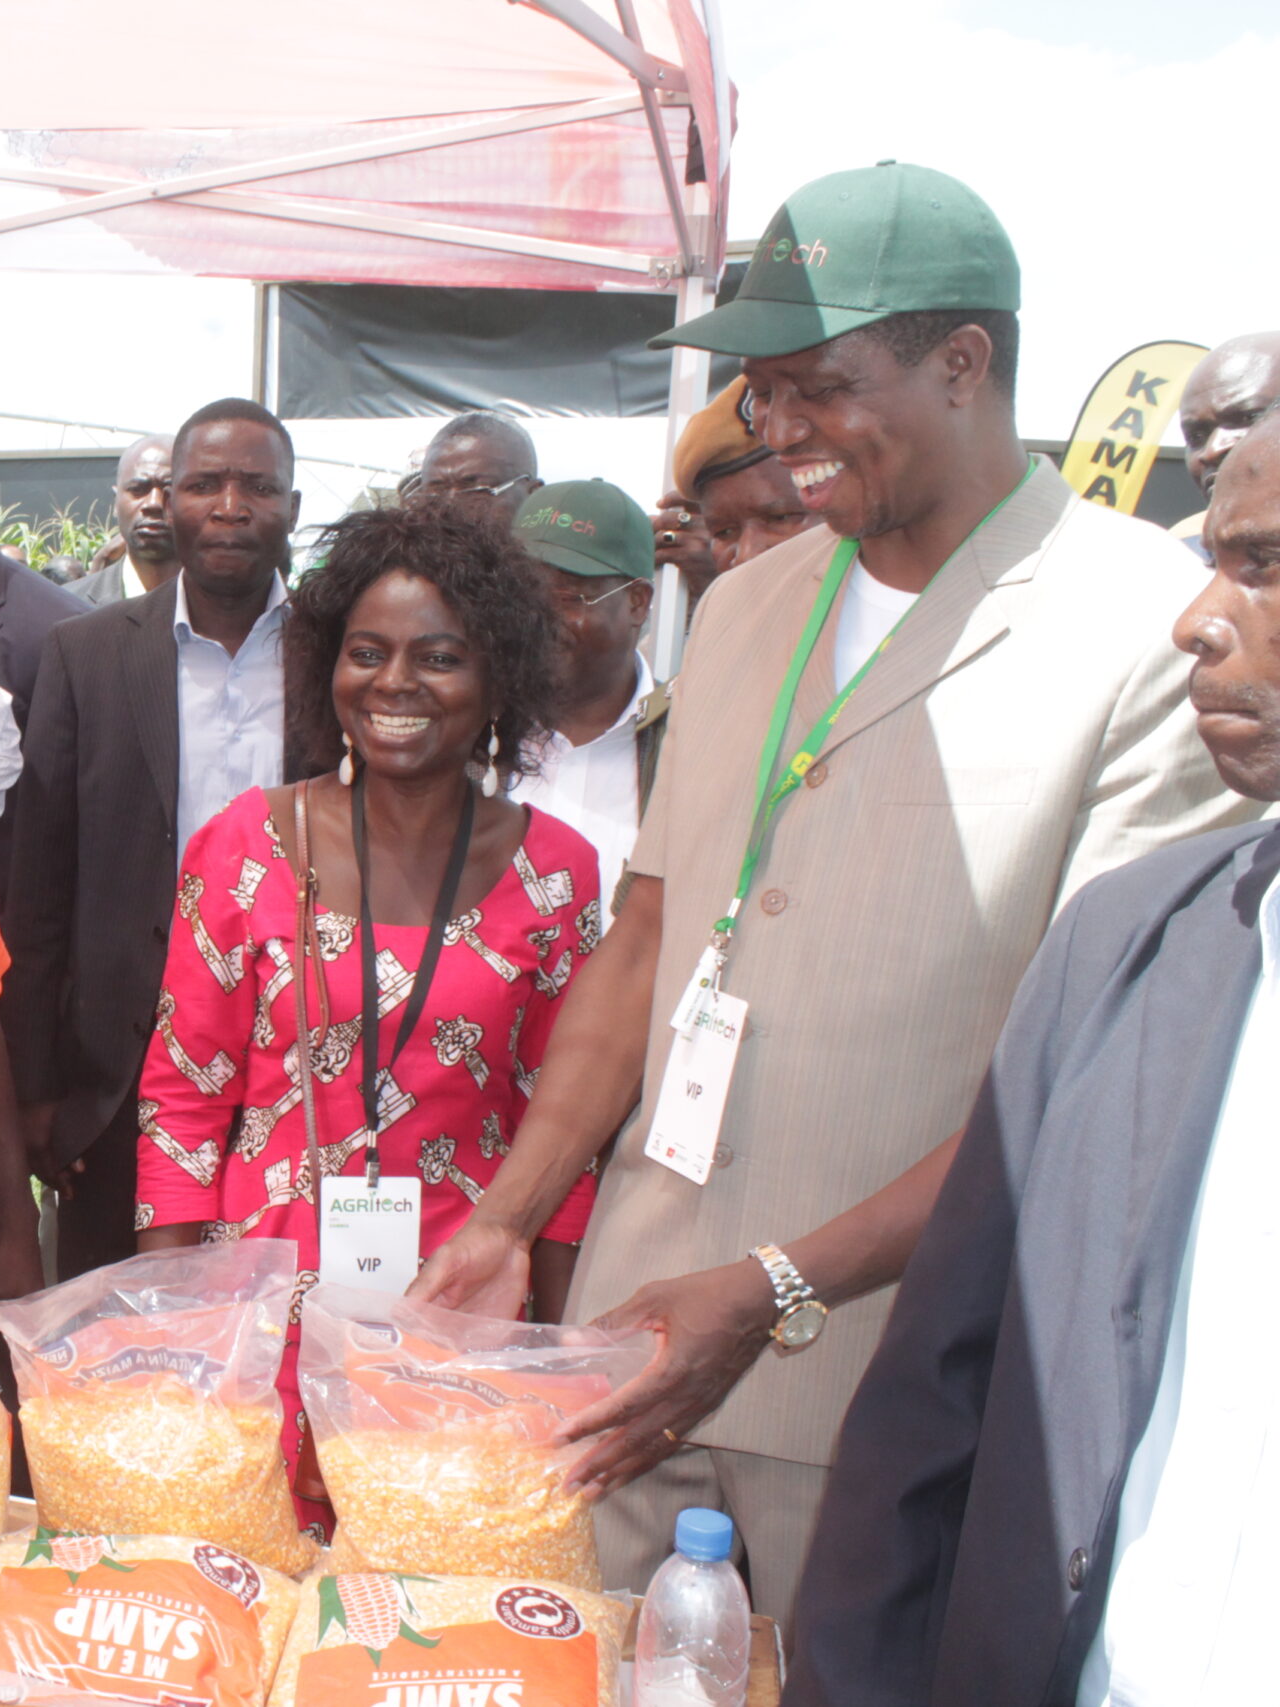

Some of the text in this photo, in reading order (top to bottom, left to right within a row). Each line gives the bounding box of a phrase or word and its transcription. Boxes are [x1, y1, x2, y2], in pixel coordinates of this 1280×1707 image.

[1080, 369, 1169, 509] KAMA
[685, 1079, 703, 1100] VIP
[357, 1257, 382, 1272] VIP
[66, 1587, 121, 1599] CHOICE
[54, 1597, 204, 1661] SAMP
[500, 1604, 577, 1637] Proudly Zambian
[76, 1641, 170, 1680] MEAL
[371, 1670, 430, 1681] CHOICE
[435, 1668, 508, 1678] HEALTHY
